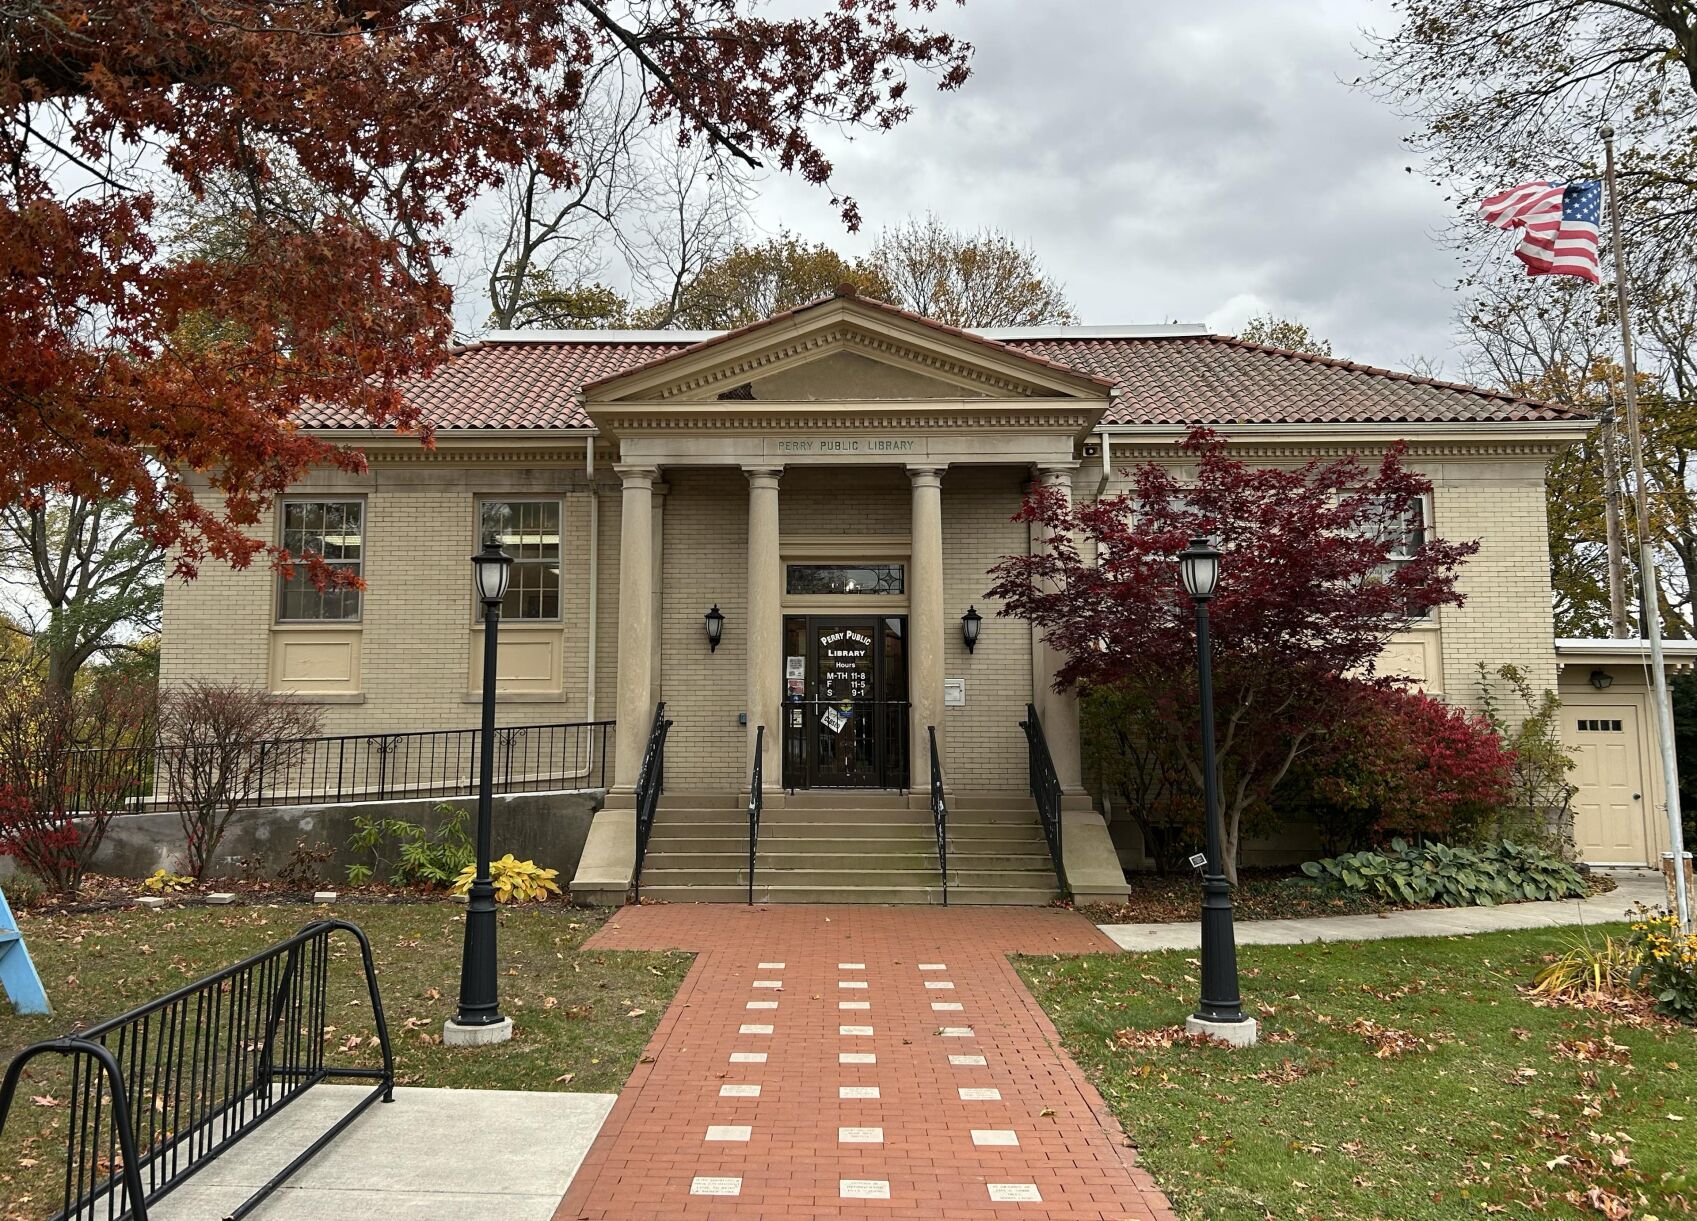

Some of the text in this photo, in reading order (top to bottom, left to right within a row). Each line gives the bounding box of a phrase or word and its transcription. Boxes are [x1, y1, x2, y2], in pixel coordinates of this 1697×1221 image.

[778, 441, 914, 451] PERRY PUBLIC LIBRARY
[820, 630, 871, 646] PERRY PUBLIC
